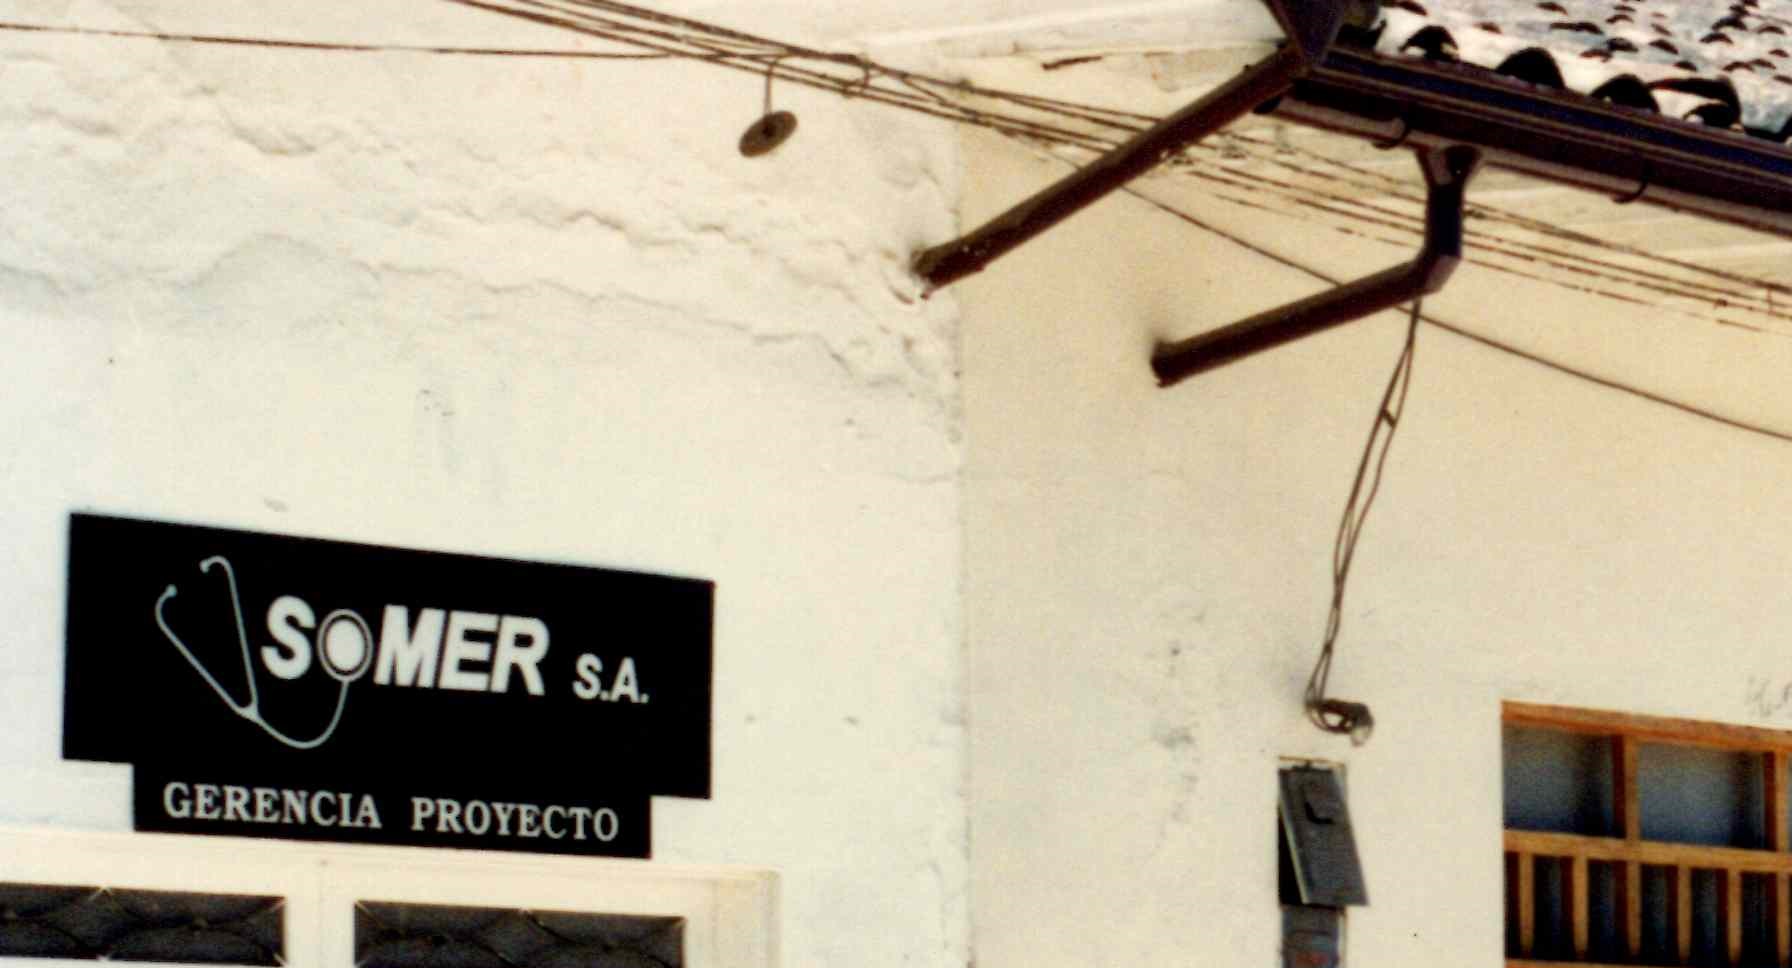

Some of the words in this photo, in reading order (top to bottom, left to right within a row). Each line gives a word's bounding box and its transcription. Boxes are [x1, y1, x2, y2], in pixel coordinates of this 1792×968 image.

[260, 595, 551, 697] SOMER
[572, 652, 650, 704] S.A.
[162, 780, 383, 830] GERENCIA
[410, 796, 620, 843] PROYECTO
